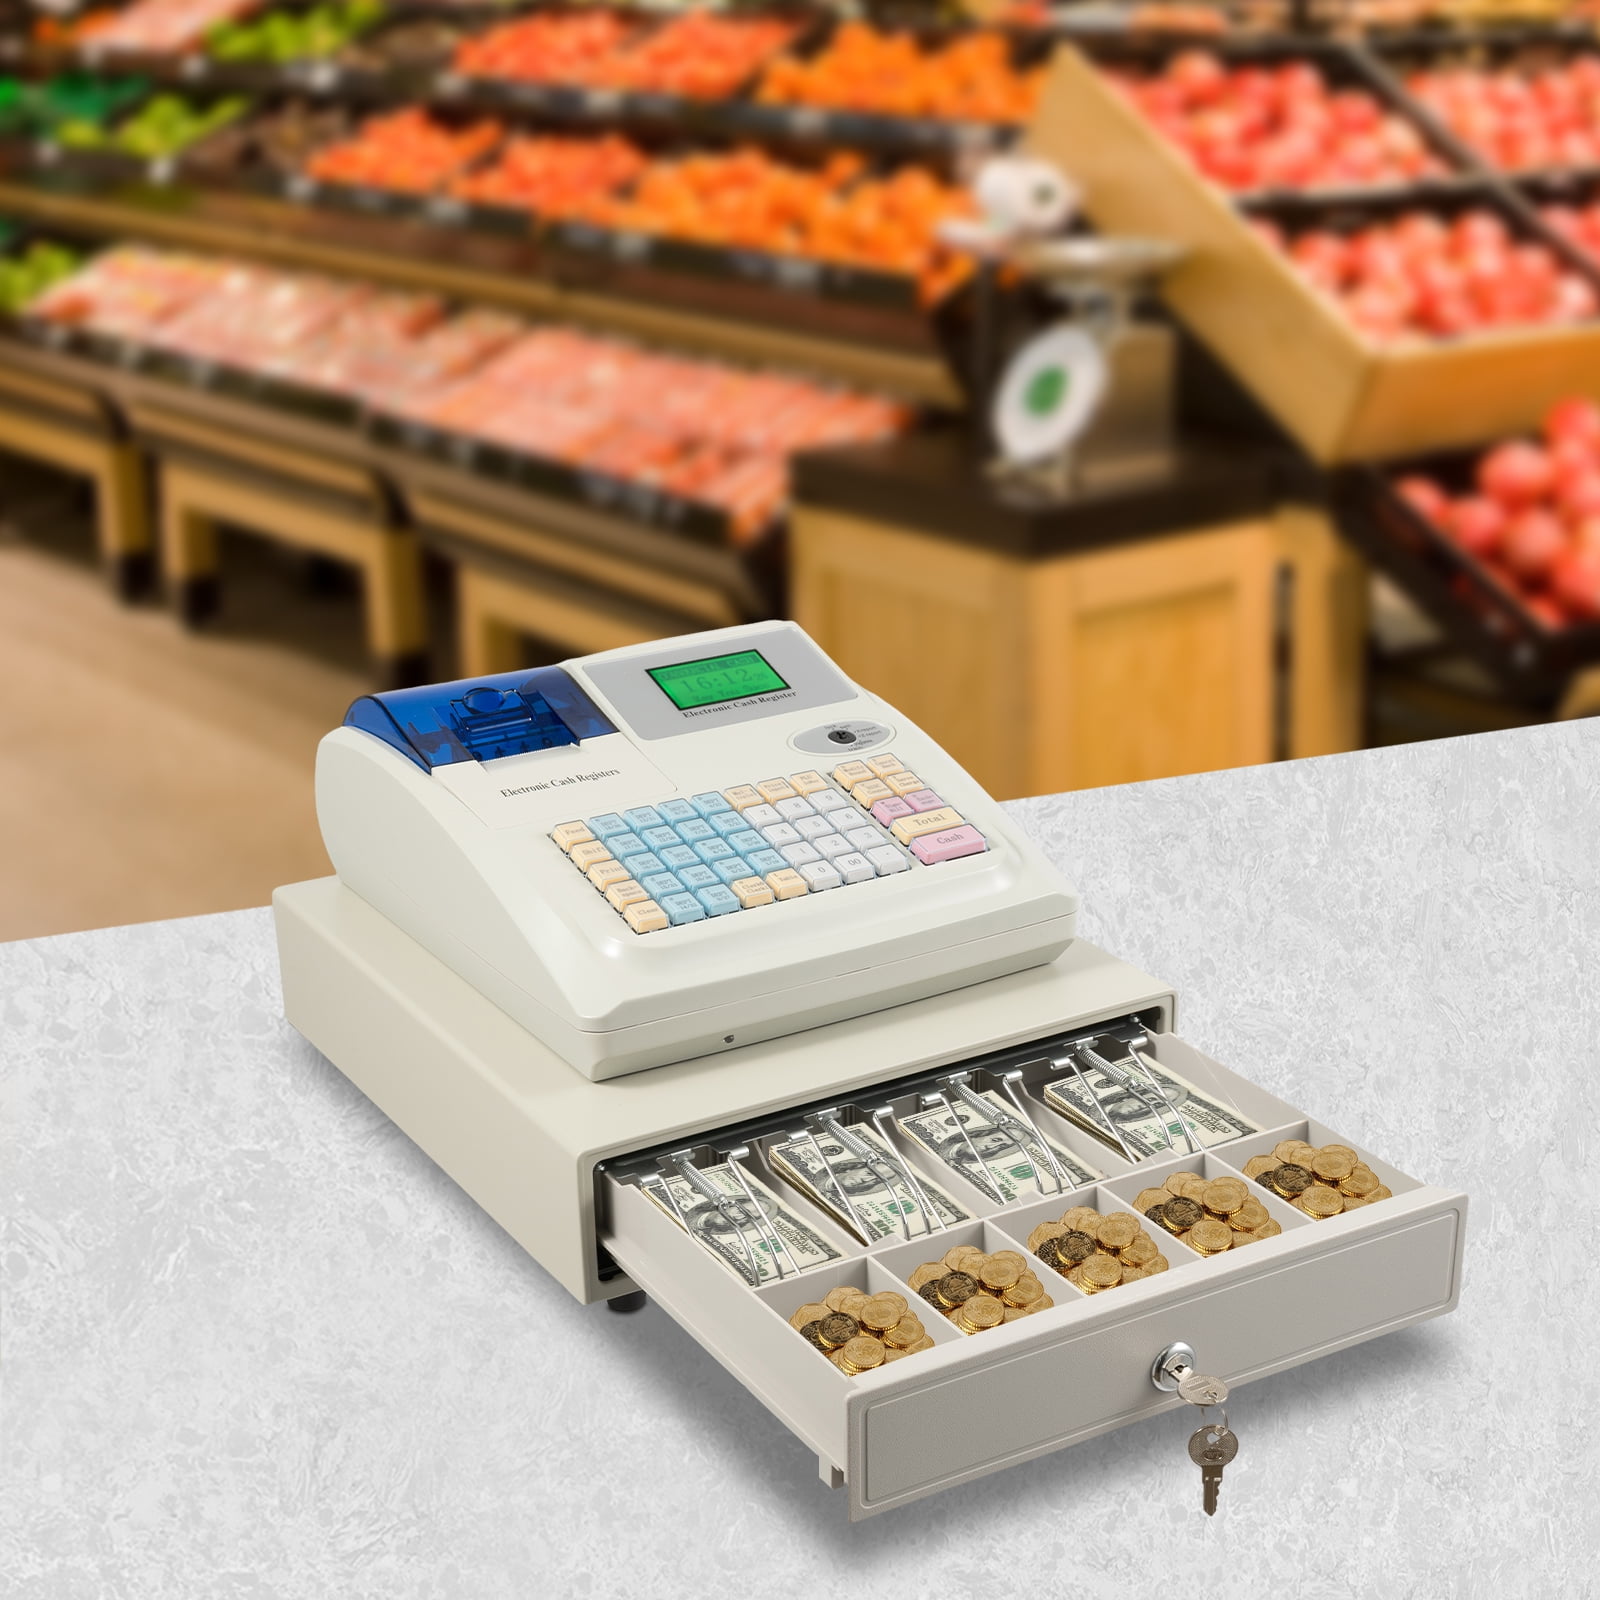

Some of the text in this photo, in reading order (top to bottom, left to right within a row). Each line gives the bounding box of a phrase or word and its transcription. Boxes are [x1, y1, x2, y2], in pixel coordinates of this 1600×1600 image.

[682, 704, 732, 718] Electronic
[733, 699, 758, 708] Cash
[758, 691, 797, 703] Register
[500, 768, 621, 797] Electronic Cash Registers
[913, 814, 946, 826] Total
[936, 833, 964, 845] Cash
[848, 858, 861, 866] 00
